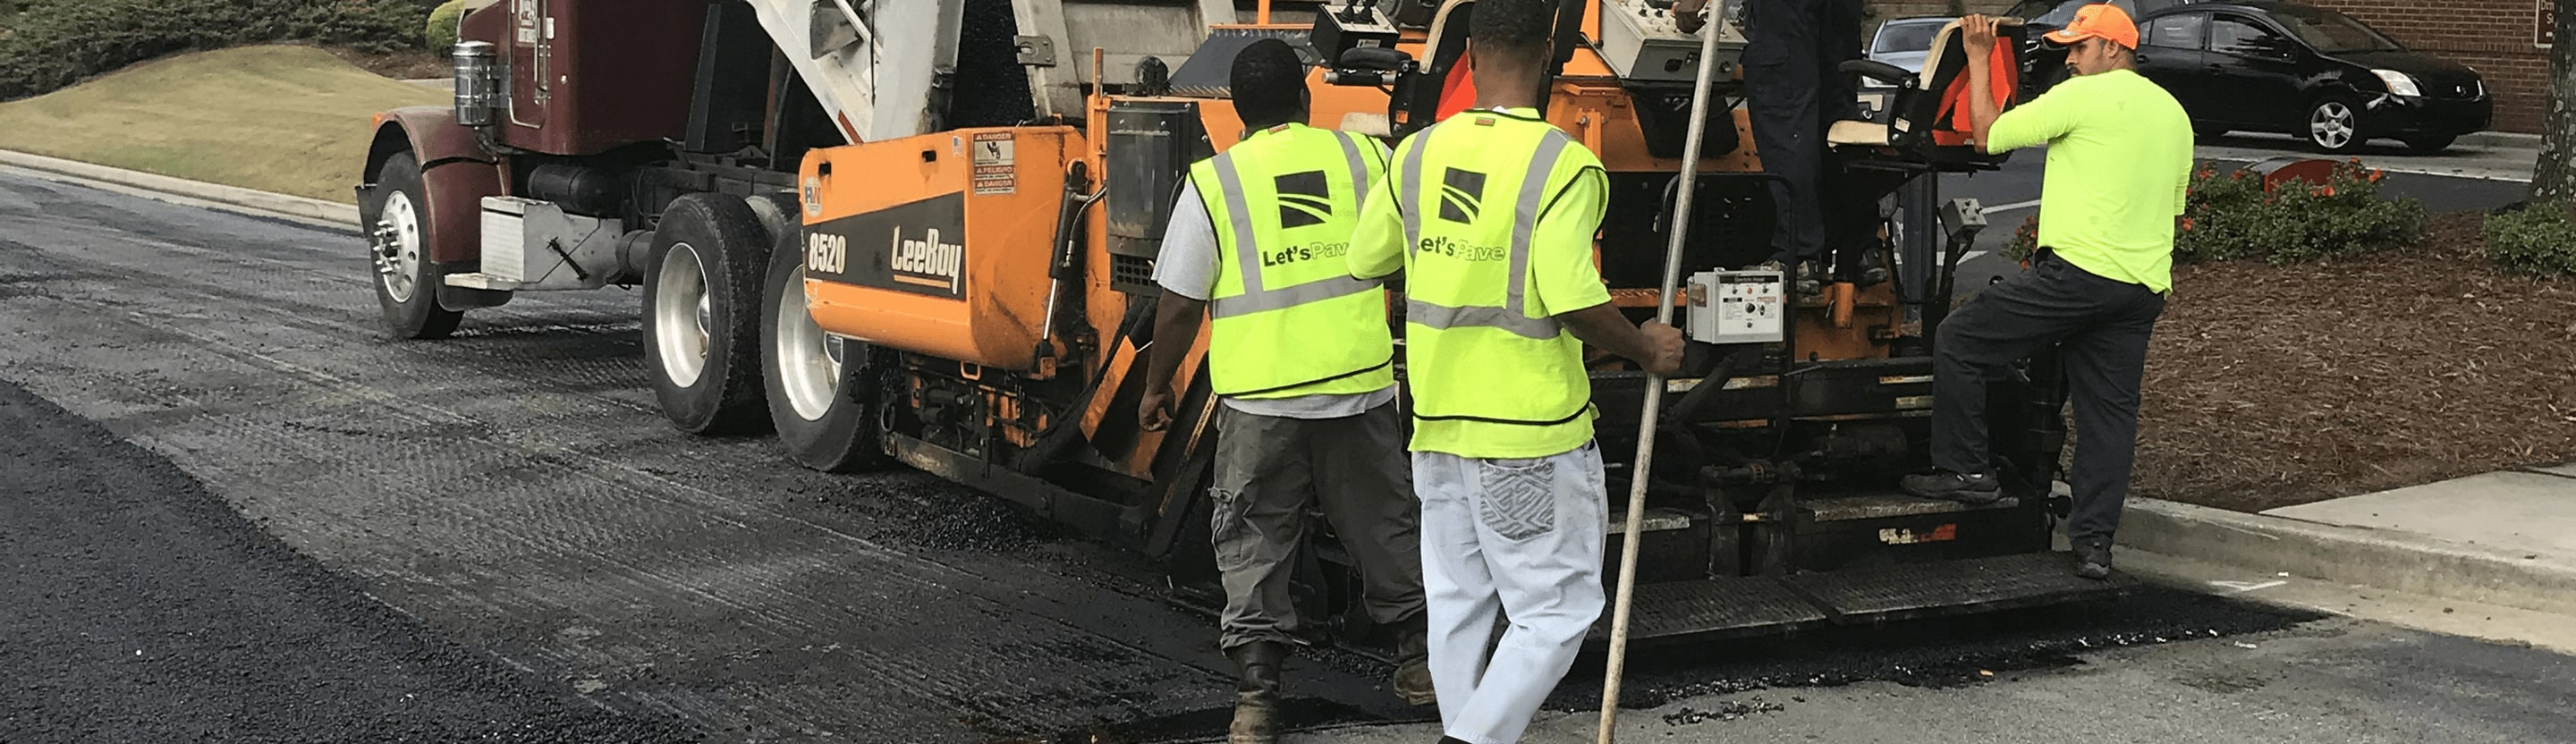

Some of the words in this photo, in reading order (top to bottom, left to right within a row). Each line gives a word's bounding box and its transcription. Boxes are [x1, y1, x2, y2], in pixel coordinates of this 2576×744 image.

[808, 232, 847, 275] 8520
[891, 225, 962, 295] LeeBoy
[1262, 241, 1350, 267] Let'sPav
[1417, 235, 1506, 262] et'sPave
